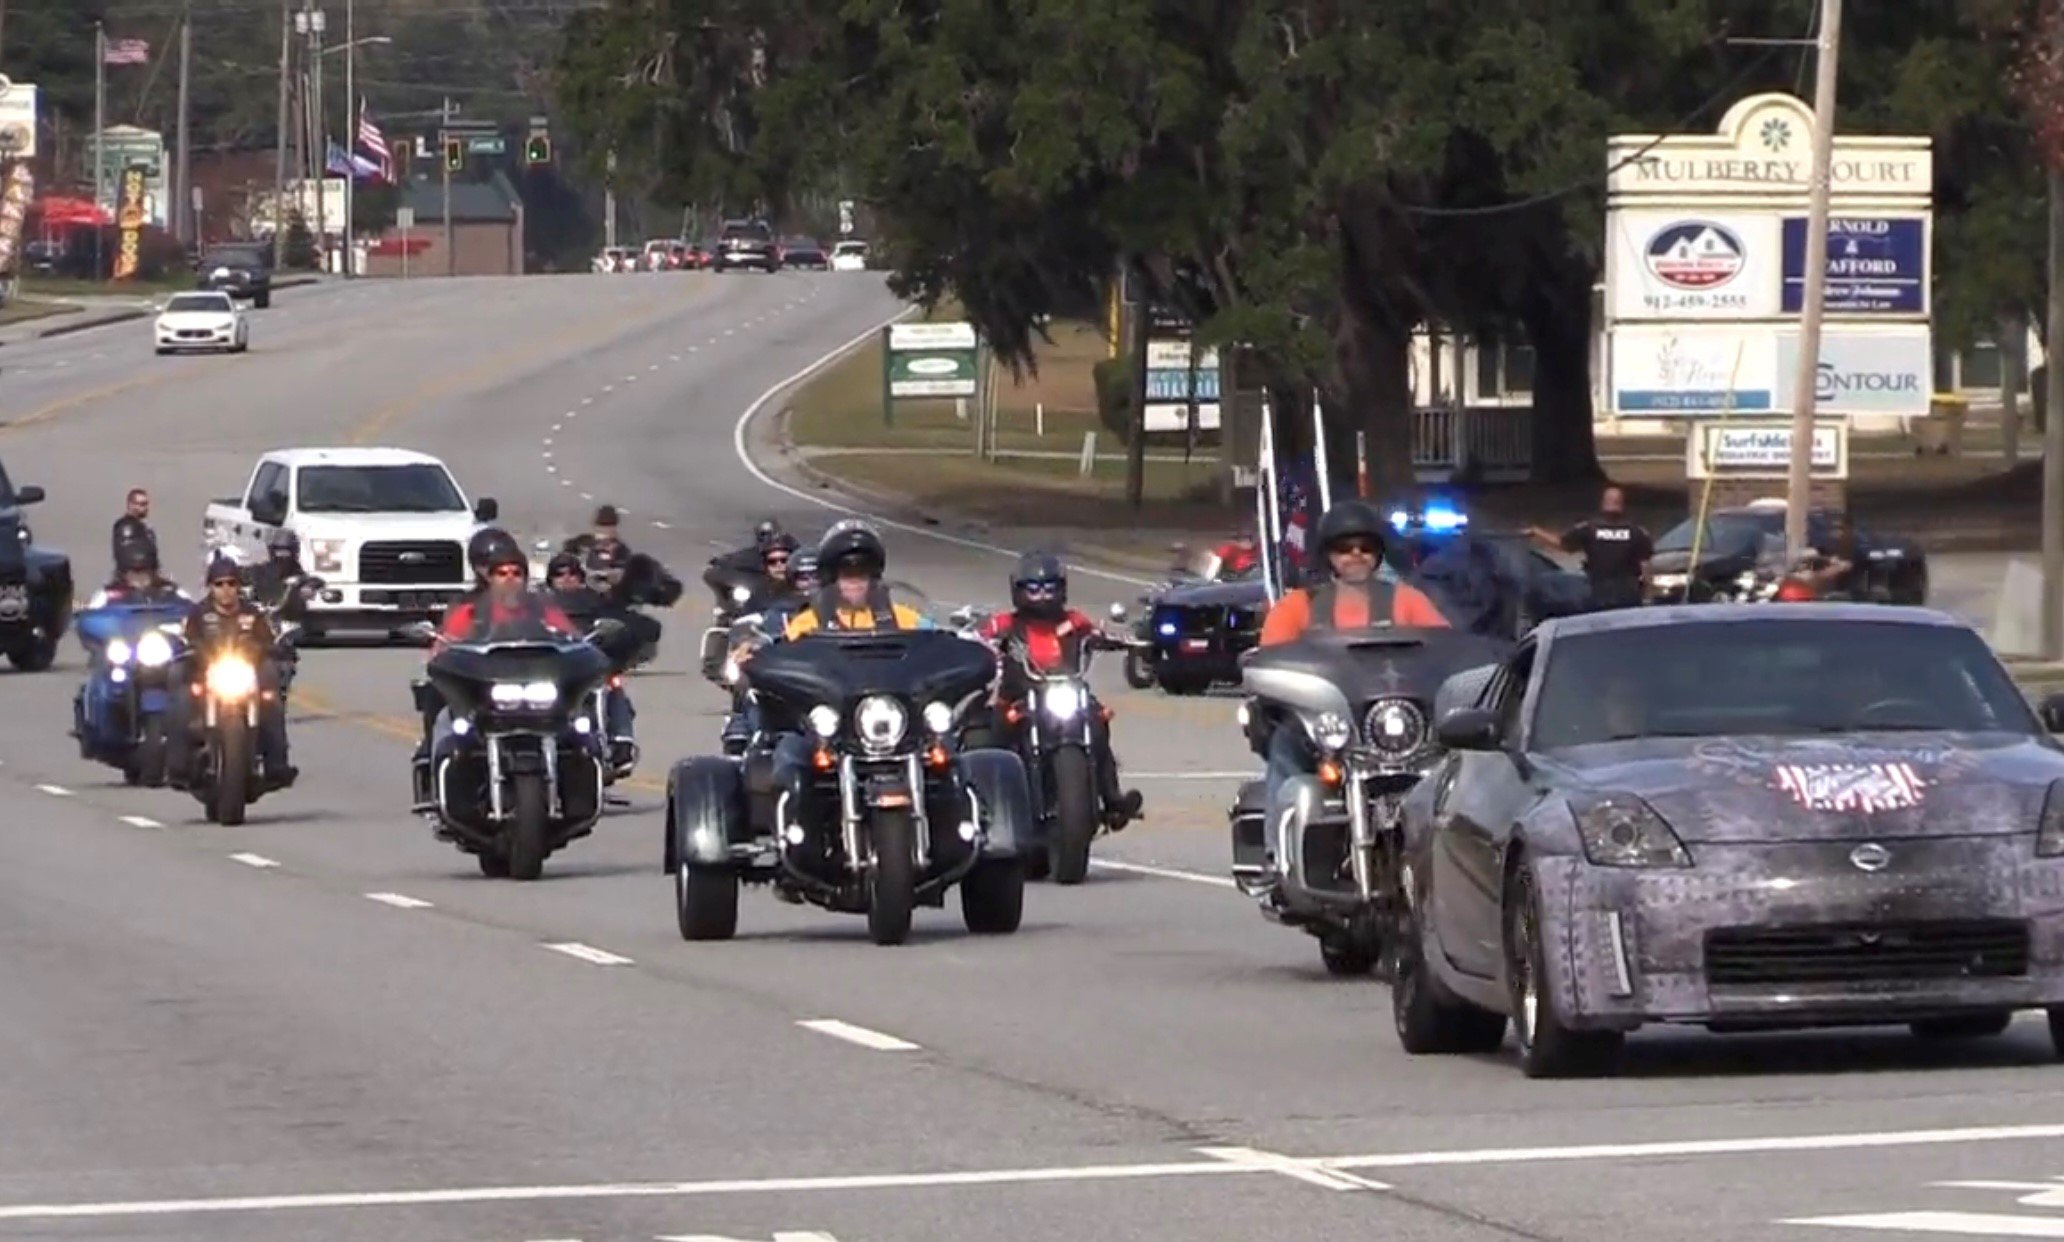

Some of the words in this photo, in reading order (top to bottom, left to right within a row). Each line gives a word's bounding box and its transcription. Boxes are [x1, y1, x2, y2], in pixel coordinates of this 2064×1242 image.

[1635, 159, 1801, 182] MULBERRY
[1831, 160, 1916, 182] OURT
[1825, 219, 1889, 234] RNOLD
[1595, 528, 1631, 541] POLICE
